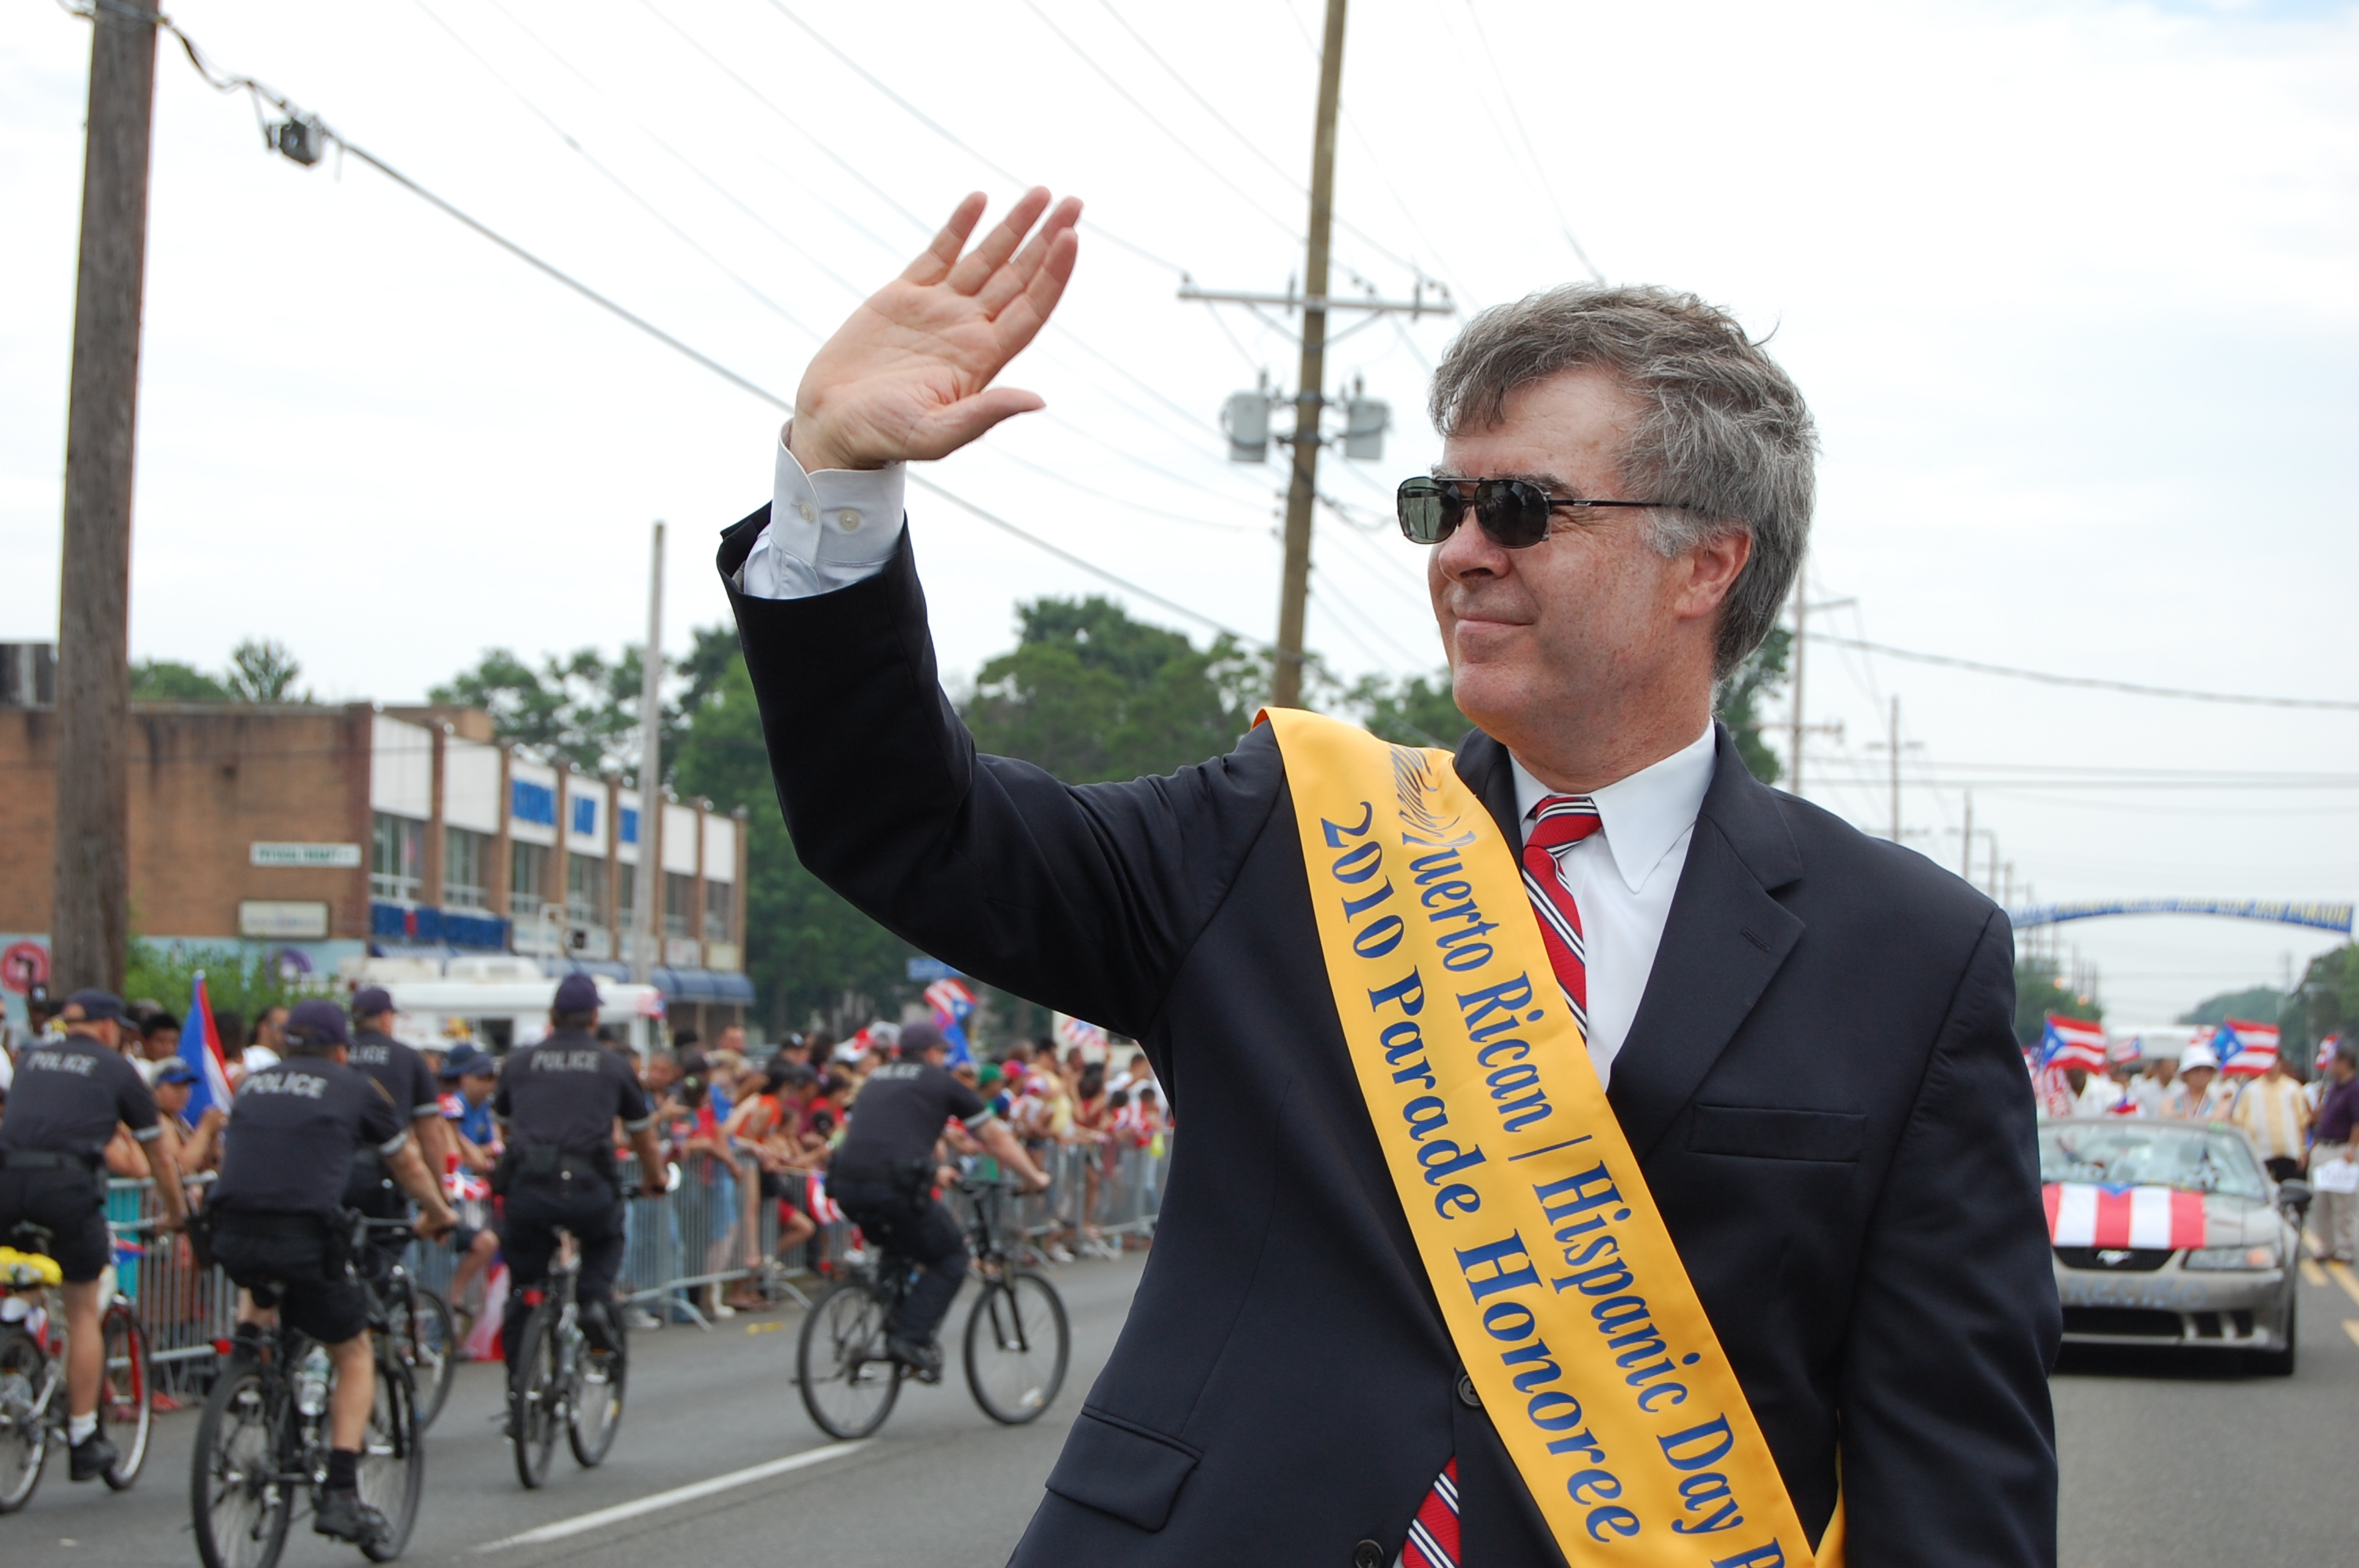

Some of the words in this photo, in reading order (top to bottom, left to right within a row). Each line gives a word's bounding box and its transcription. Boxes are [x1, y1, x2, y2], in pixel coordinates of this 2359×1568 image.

[26, 1050, 98, 1076] POLICE
[530, 1049, 601, 1073] POLICE
[240, 1071, 329, 1099] POLICE
[1321, 801, 1405, 959] 2010
[1367, 965, 1487, 1220] Parade
[1453, 1227, 1641, 1544] Honoree
[1401, 830, 1500, 972] Puerto
[1456, 971, 1553, 1133] Rican
[1532, 1159, 1701, 1413] Hispanic
[1656, 1411, 1744, 1536] Day
